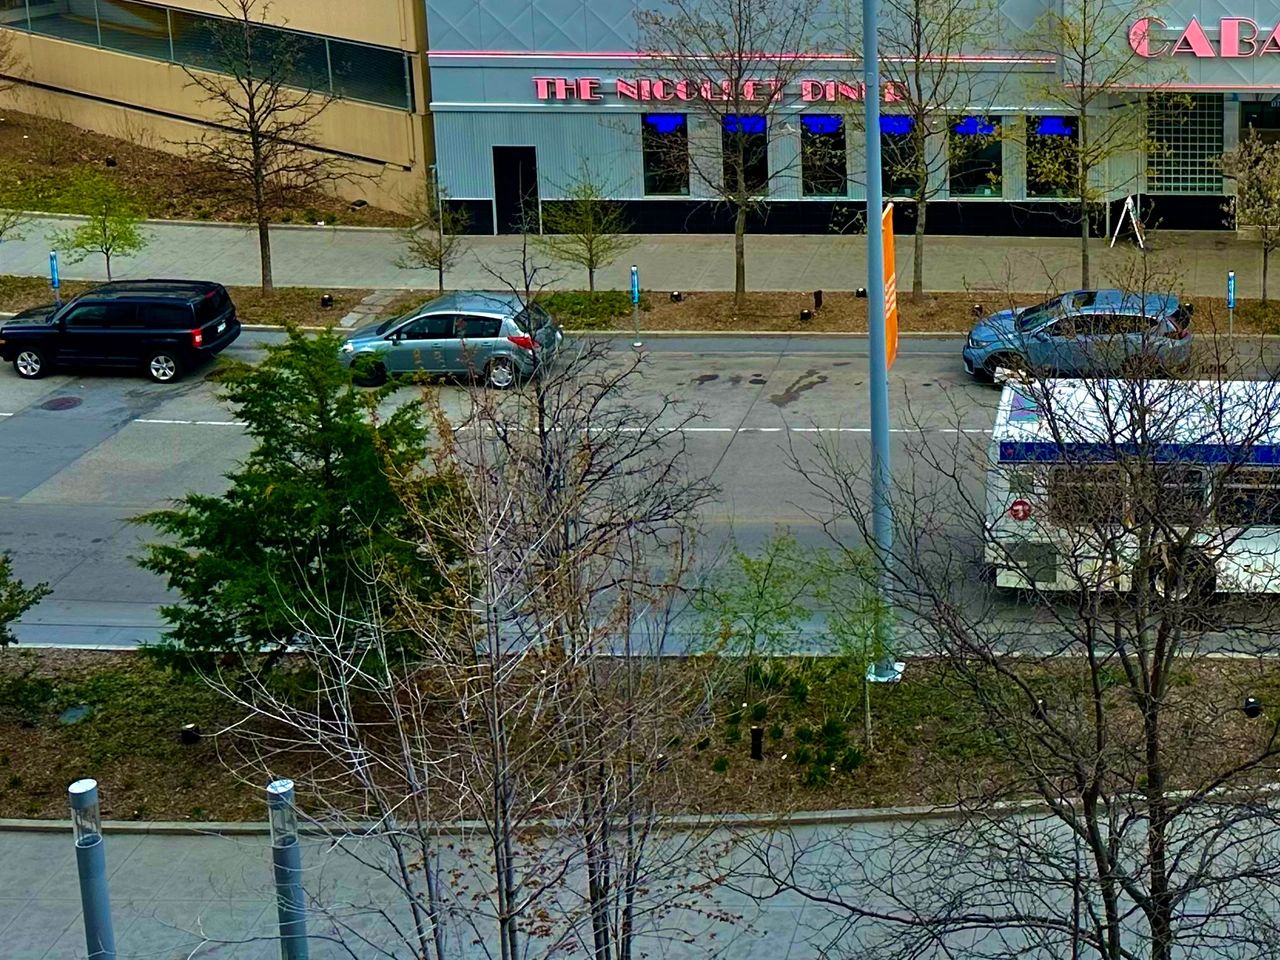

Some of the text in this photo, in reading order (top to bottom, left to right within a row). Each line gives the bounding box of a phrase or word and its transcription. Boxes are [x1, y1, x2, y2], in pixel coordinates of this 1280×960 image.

[532, 76, 907, 104] THE NICOLLET DINR
